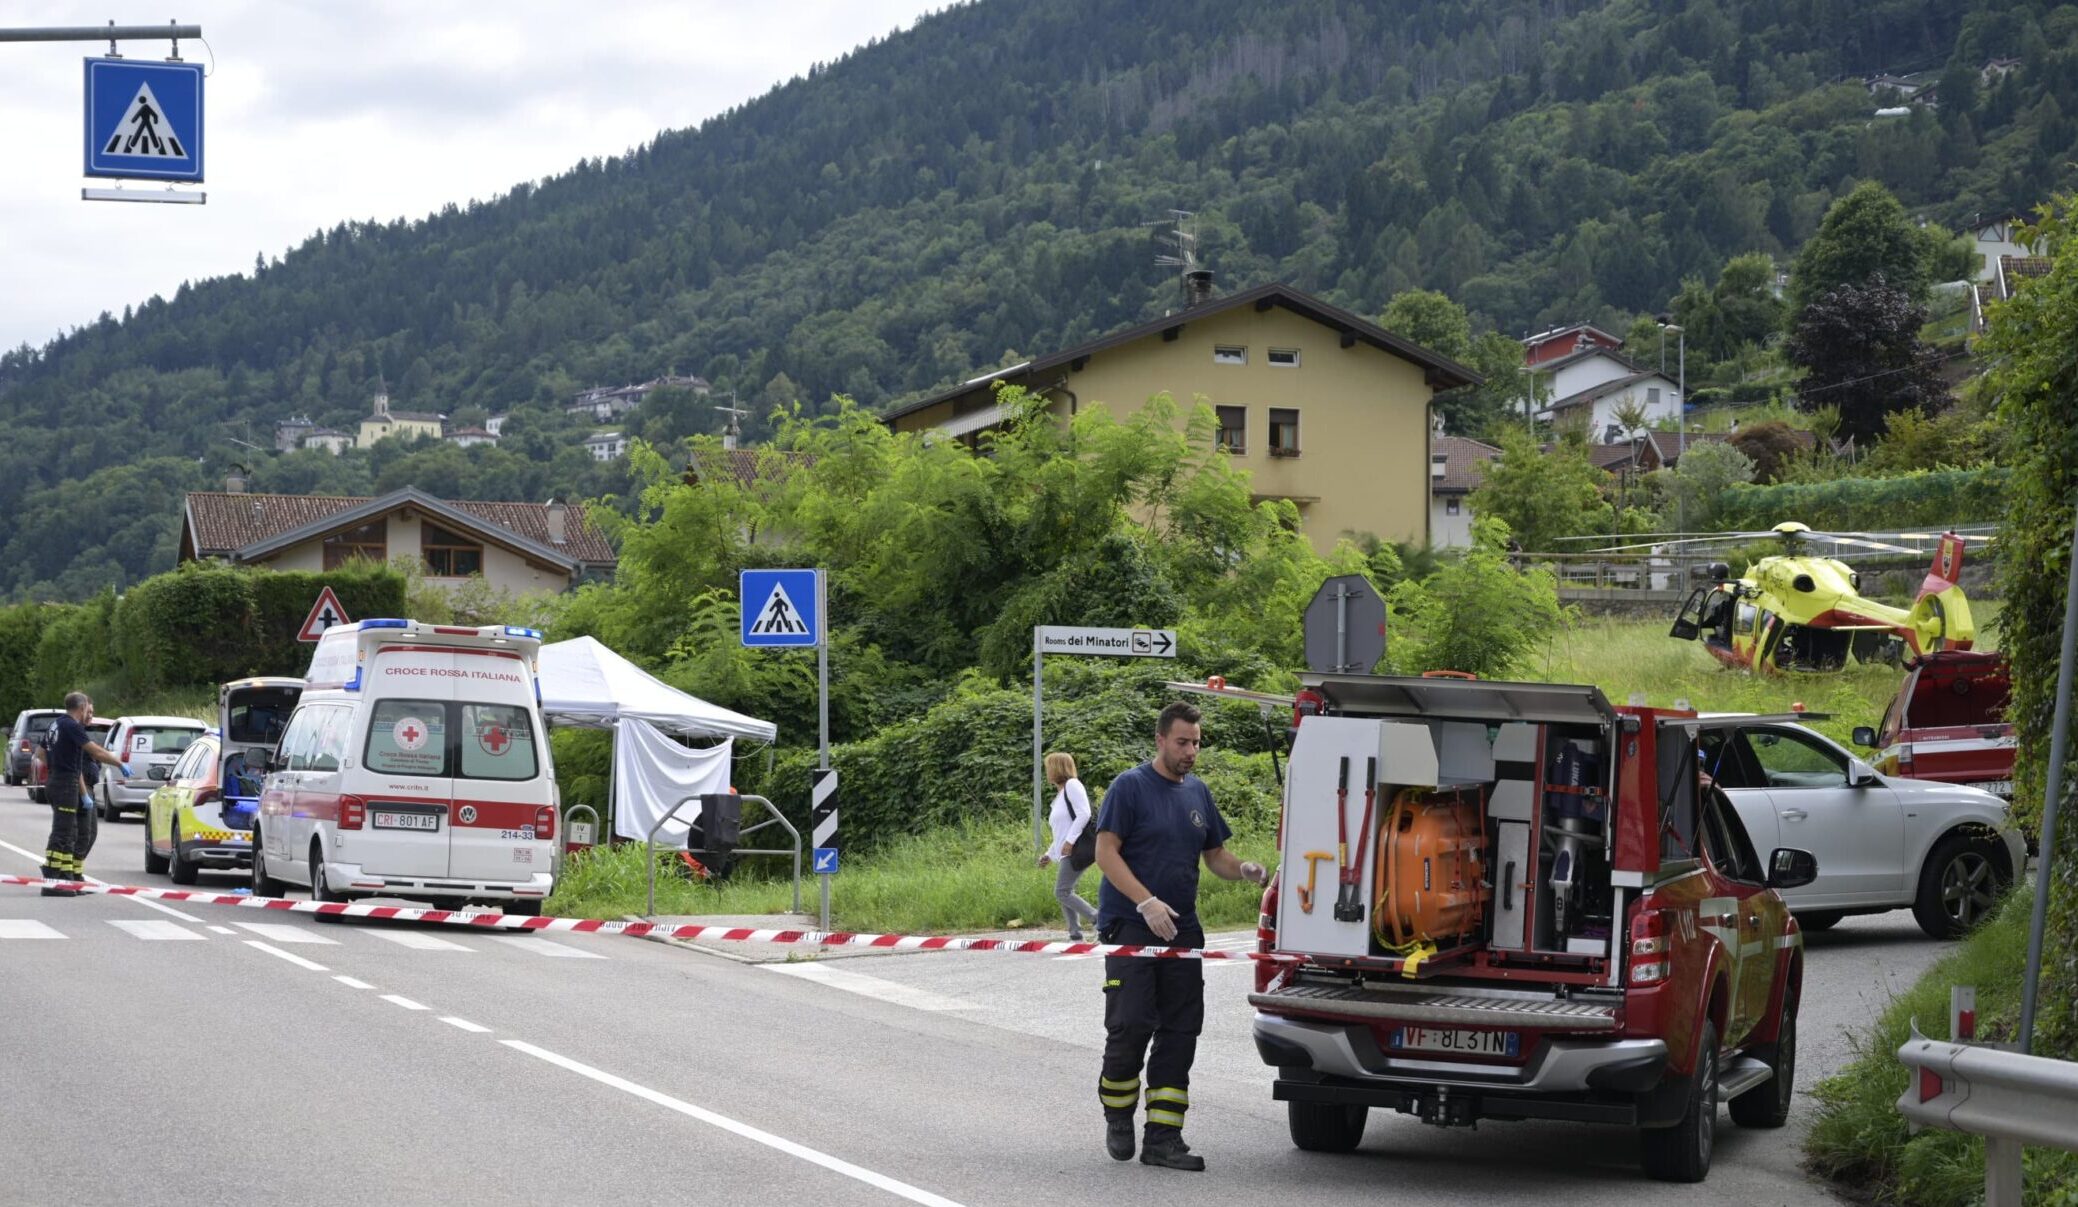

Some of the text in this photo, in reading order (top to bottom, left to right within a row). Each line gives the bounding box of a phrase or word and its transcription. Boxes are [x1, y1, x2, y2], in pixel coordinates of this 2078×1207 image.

[1045, 635, 1129, 648] Rooms dei Minatori
[385, 667, 521, 683] CROCE ROSSA ITALIANA
[137, 737, 147, 750] P
[1570, 761, 1581, 786] LUKA
[377, 814, 394, 826] CRI
[501, 830, 533, 840] 214-33
[1407, 1027, 1427, 1047] VF
